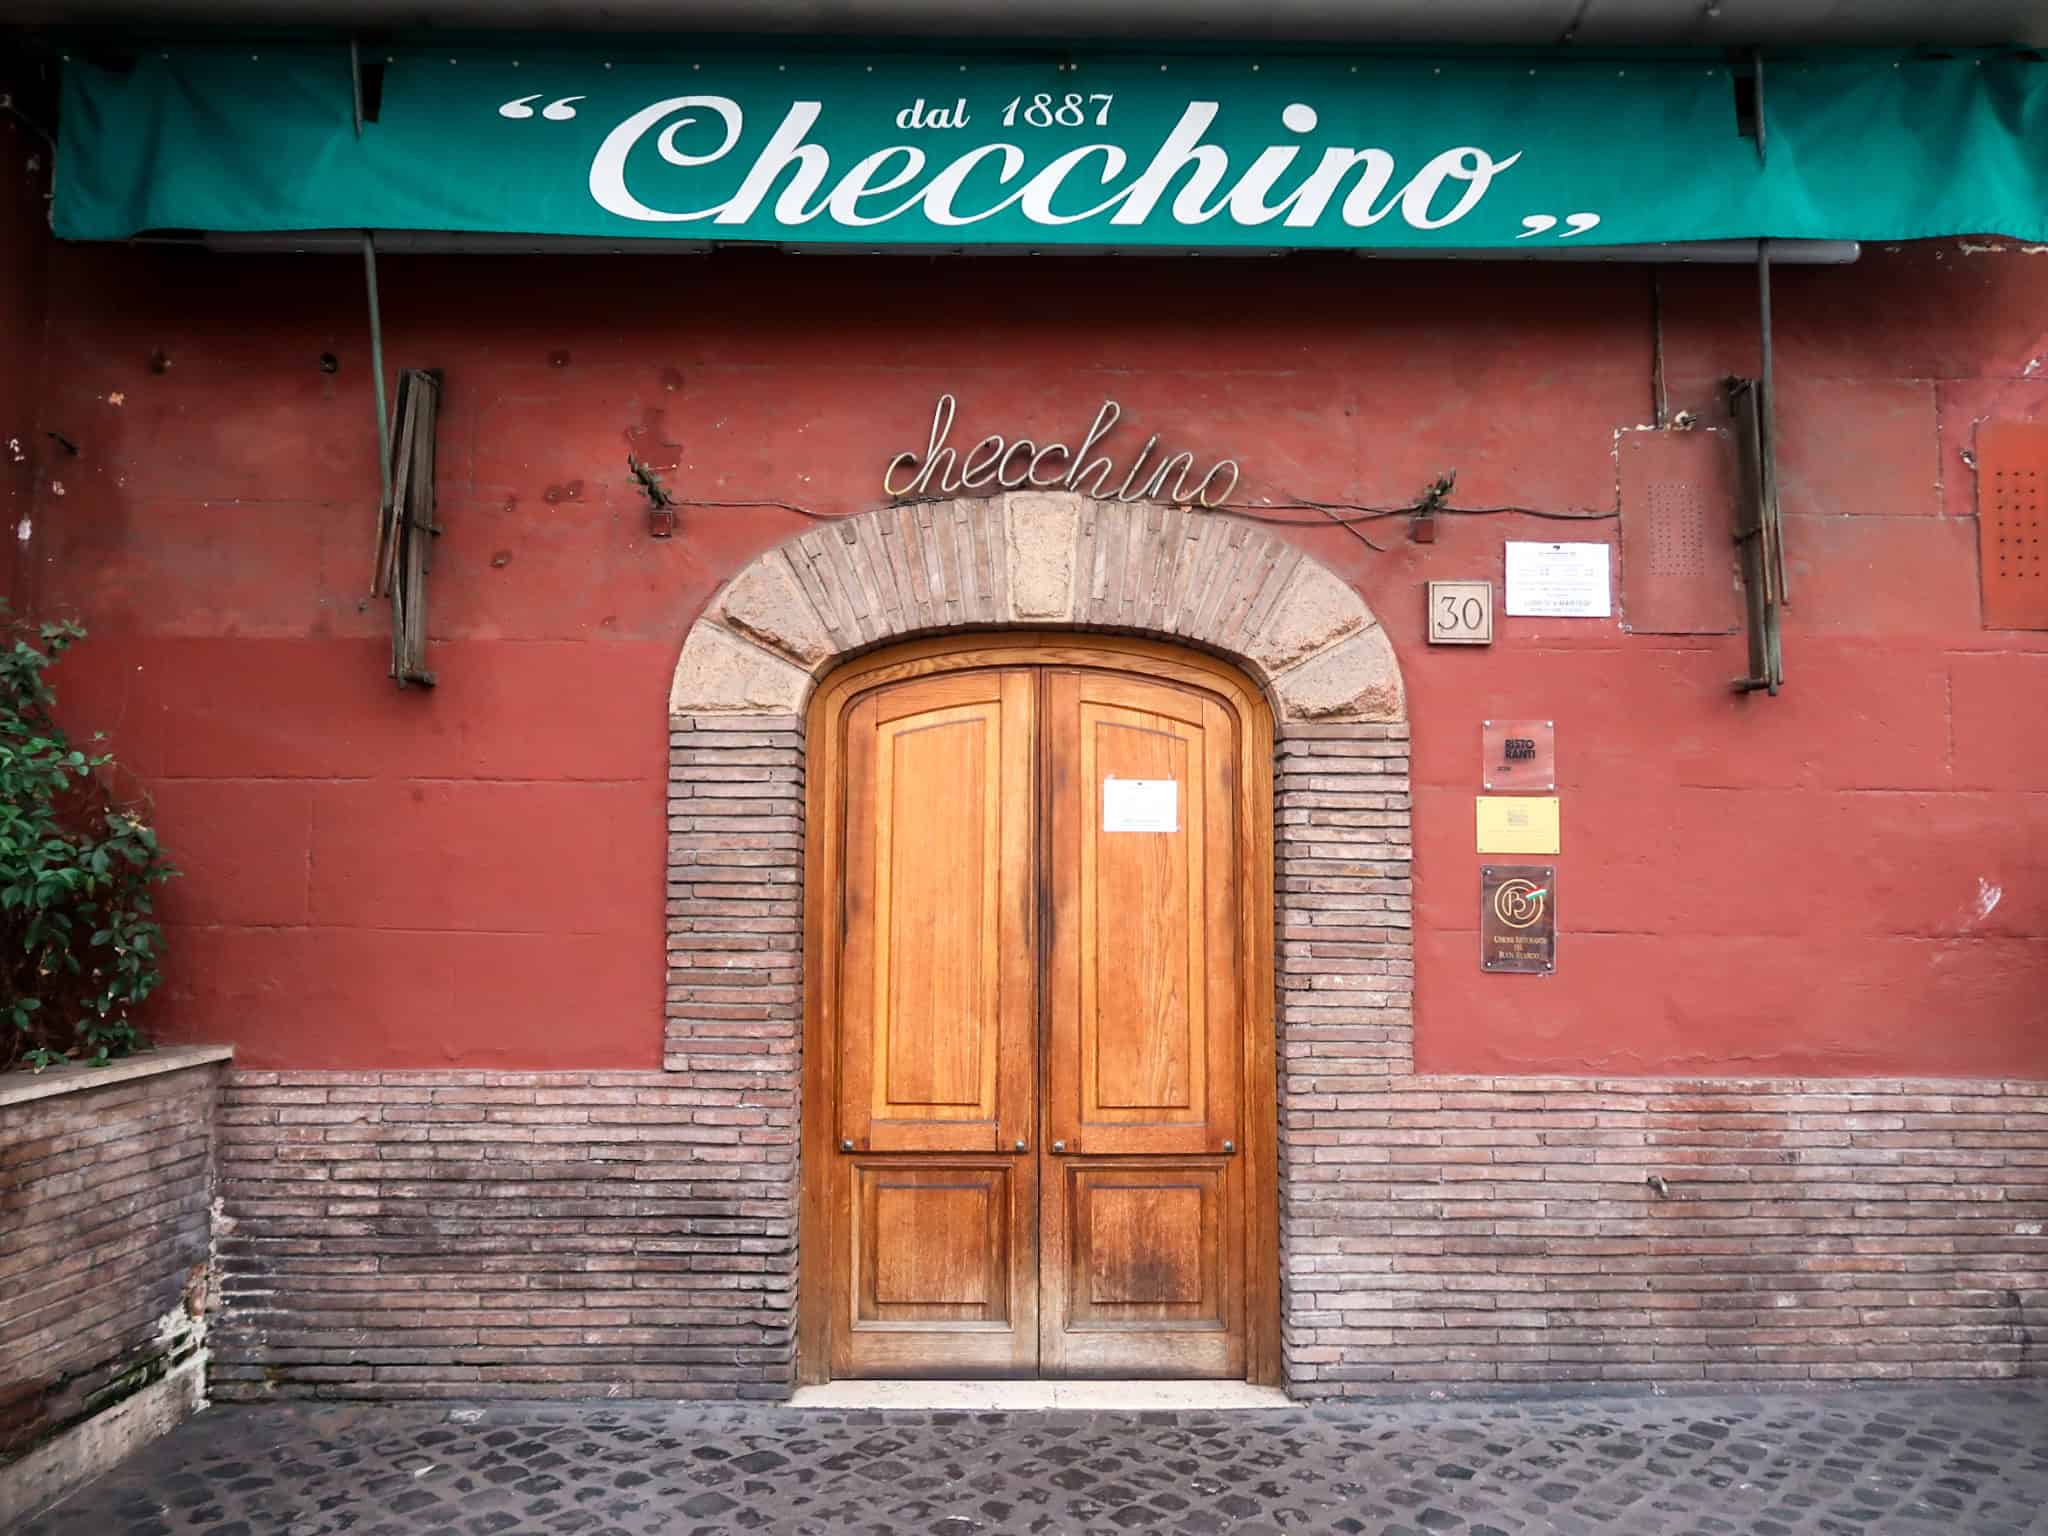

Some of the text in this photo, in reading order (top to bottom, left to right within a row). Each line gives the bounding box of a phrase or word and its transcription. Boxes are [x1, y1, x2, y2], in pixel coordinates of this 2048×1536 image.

[896, 93, 1113, 129] dal 1887
[884, 394, 1239, 507] checchino
[1437, 596, 1483, 630] 30
